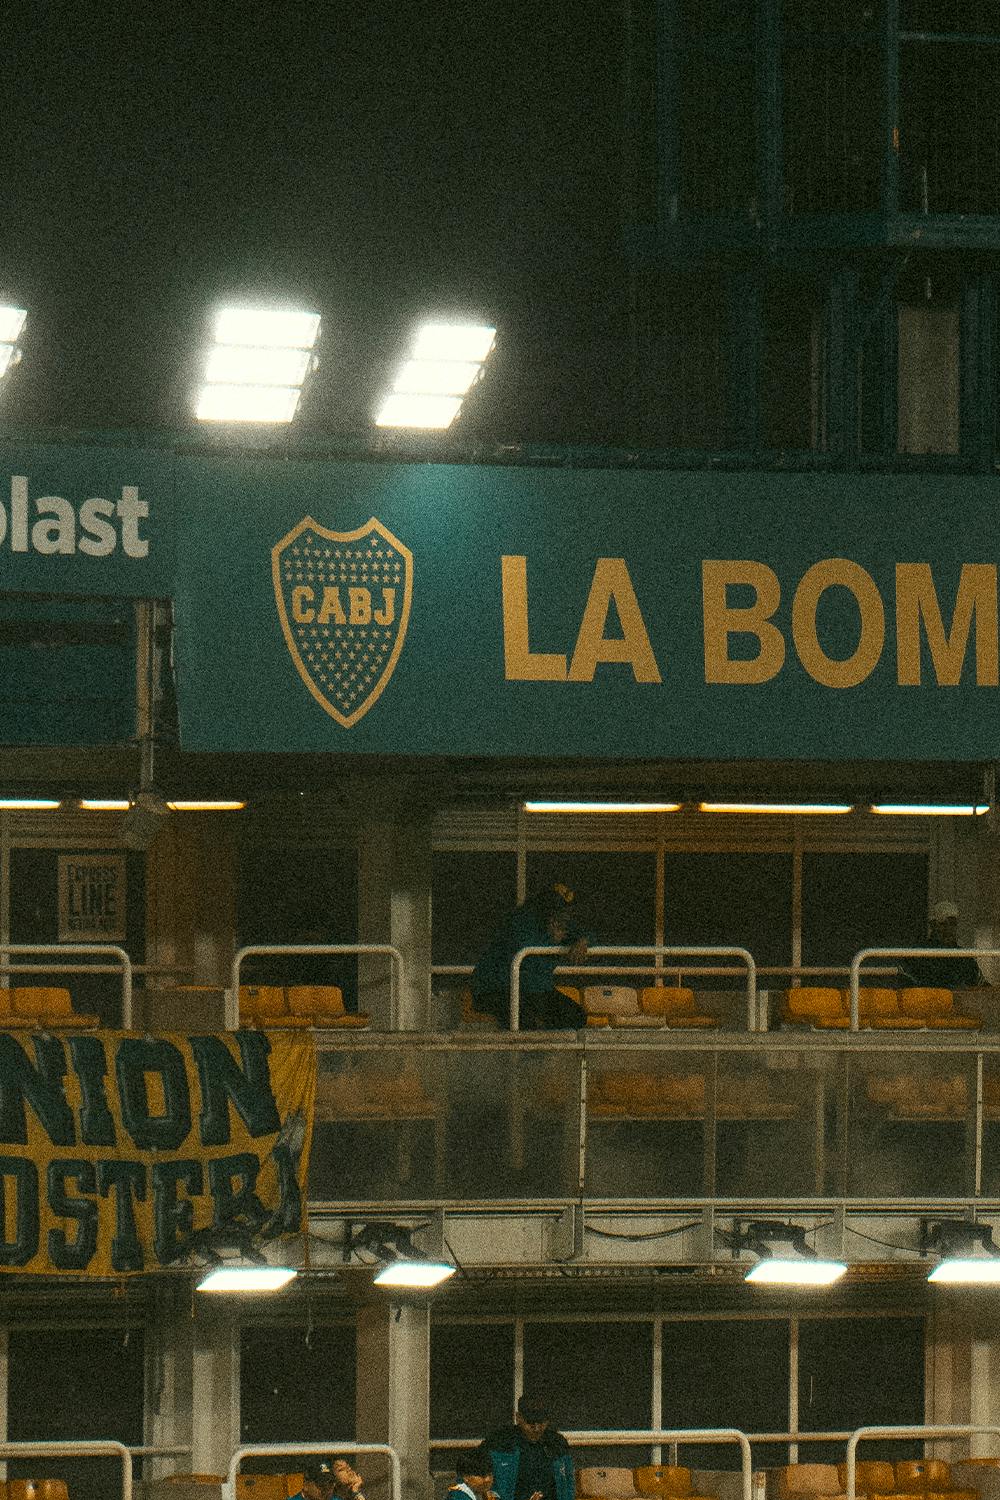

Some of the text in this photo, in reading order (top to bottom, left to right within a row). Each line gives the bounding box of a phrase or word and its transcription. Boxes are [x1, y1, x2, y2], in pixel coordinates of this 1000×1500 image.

[0, 475, 149, 558] last
[291, 585, 396, 628] CABJ
[501, 555, 663, 684] LA
